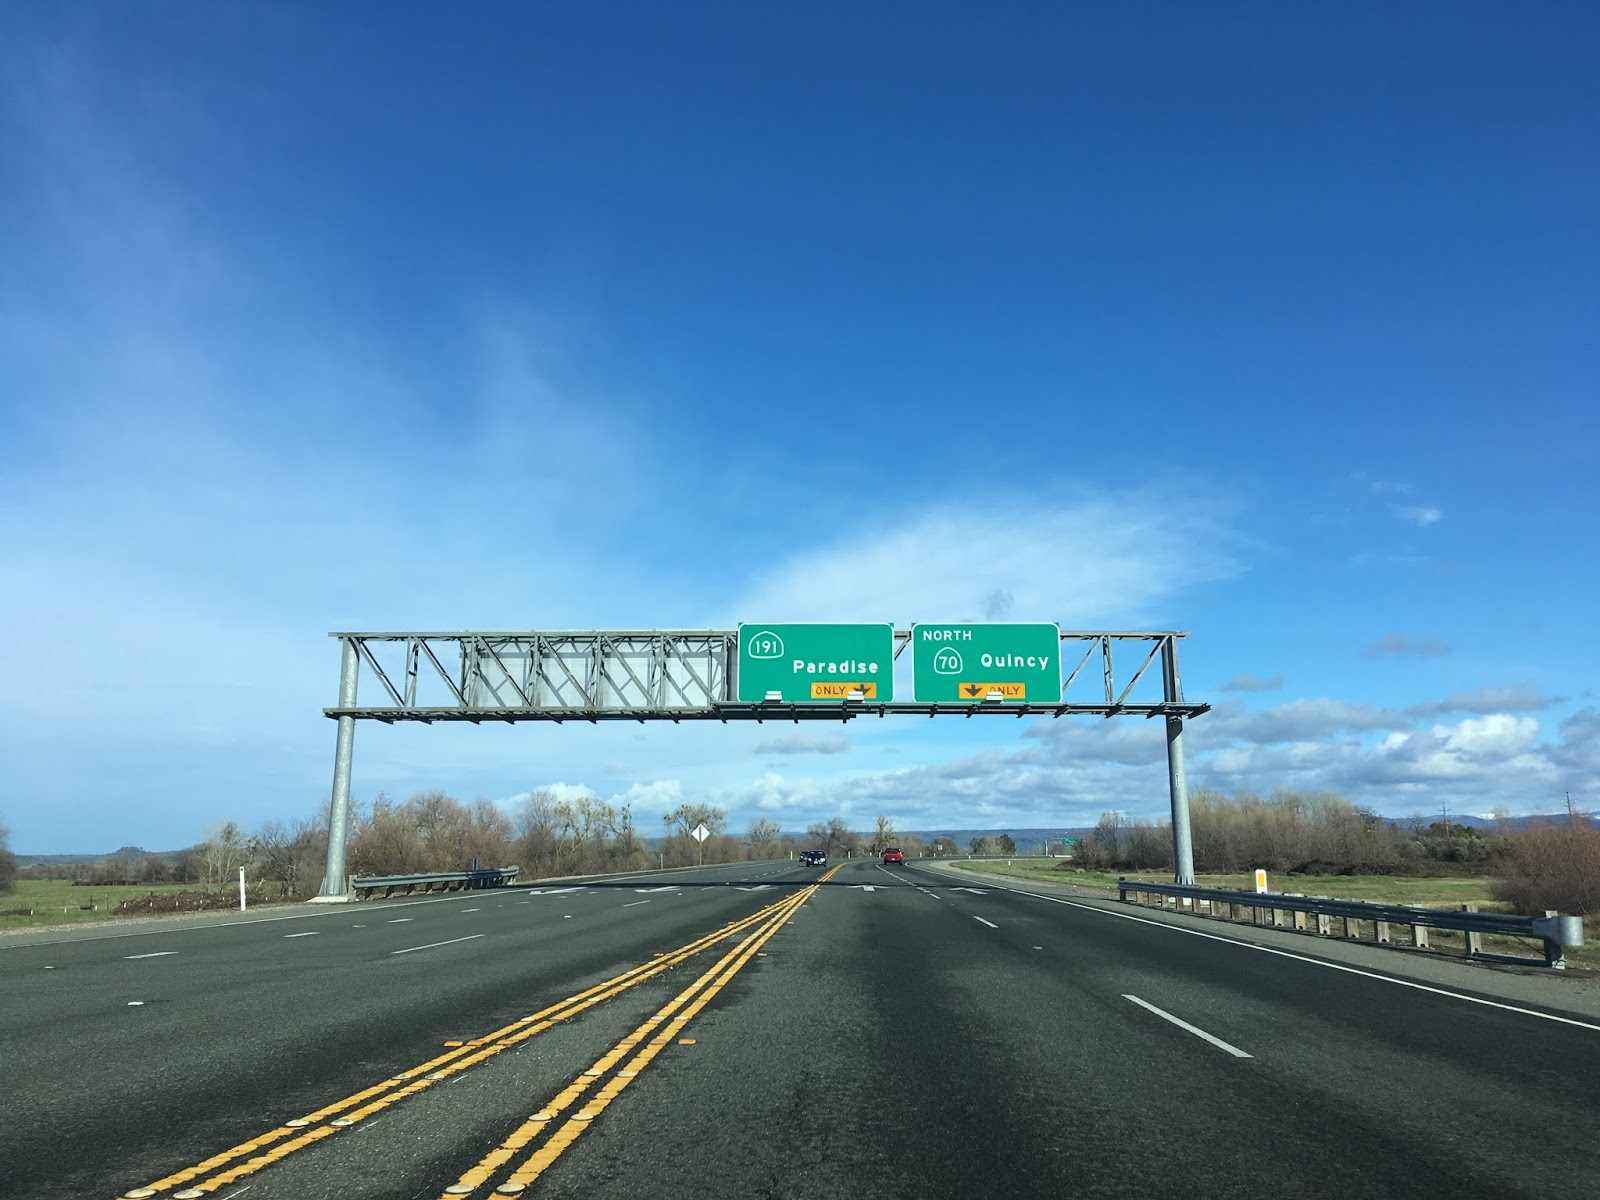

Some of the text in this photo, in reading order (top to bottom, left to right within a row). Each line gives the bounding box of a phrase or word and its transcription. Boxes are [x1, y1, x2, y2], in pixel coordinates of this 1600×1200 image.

[922, 630, 972, 641] NORTH
[755, 640, 777, 654] 191
[793, 660, 879, 674] Paradise
[938, 656, 958, 670] 70
[980, 653, 1049, 671] Quincy
[815, 686, 846, 695] ONLY
